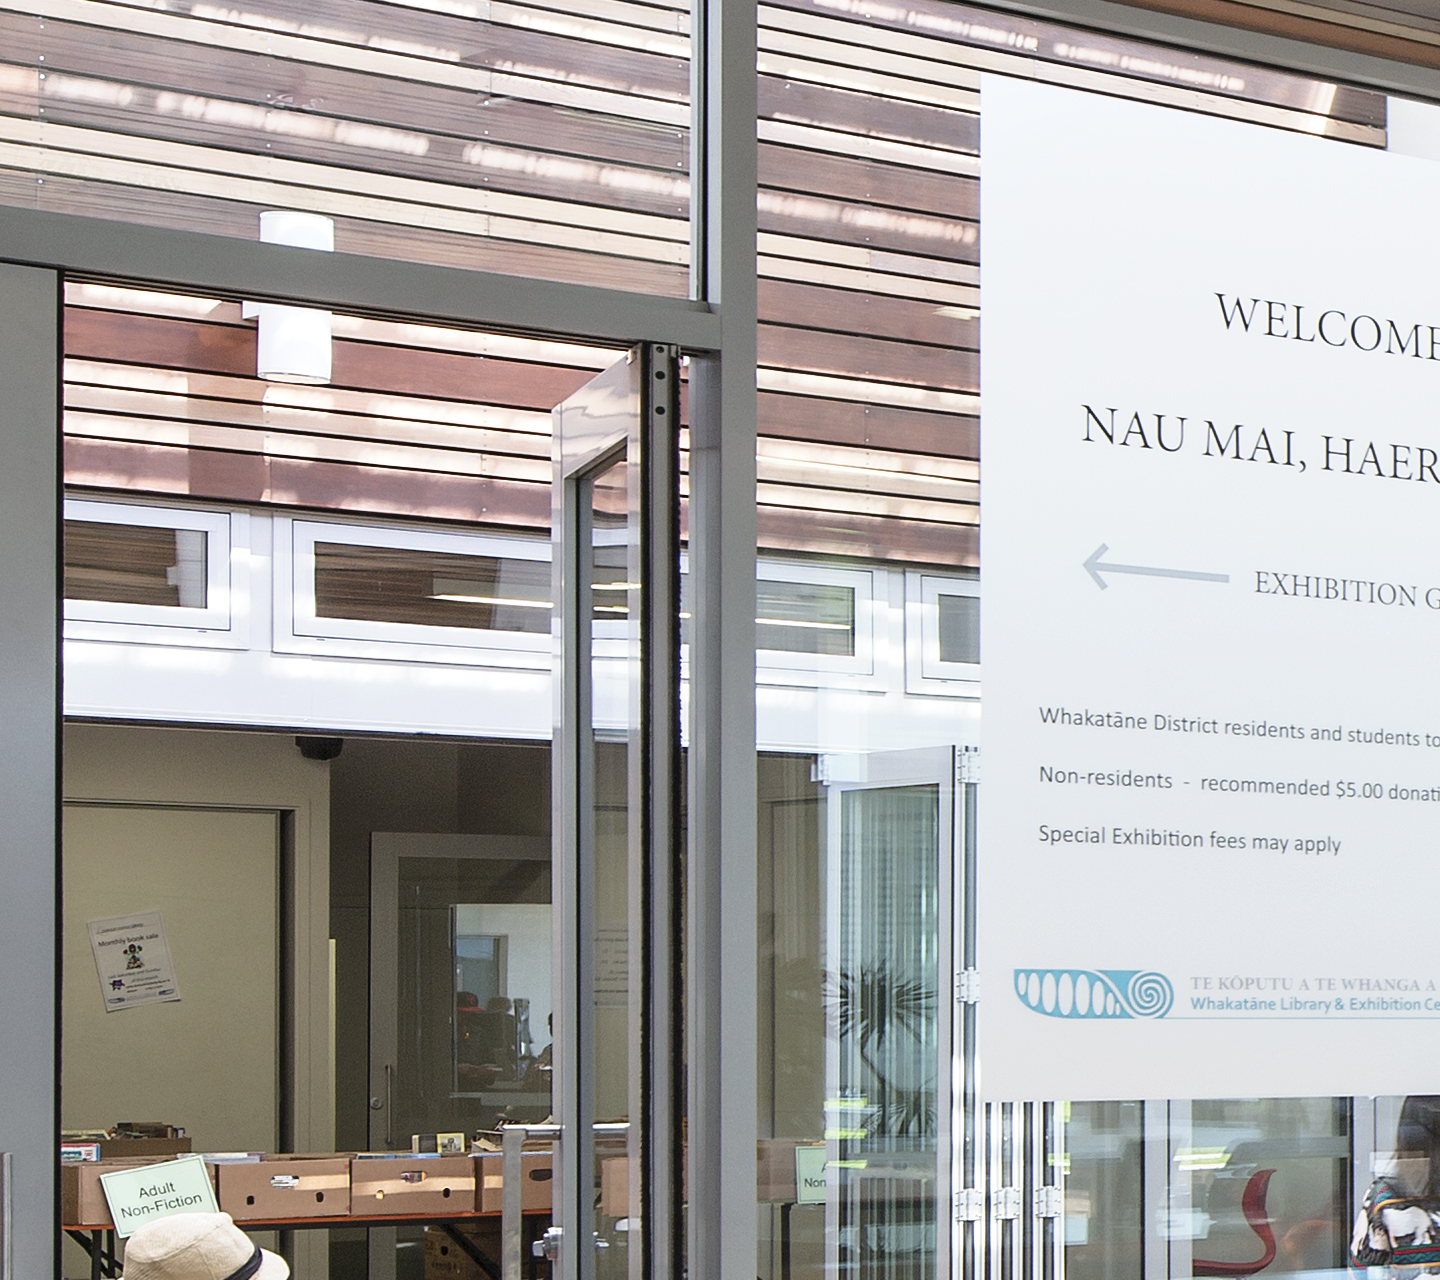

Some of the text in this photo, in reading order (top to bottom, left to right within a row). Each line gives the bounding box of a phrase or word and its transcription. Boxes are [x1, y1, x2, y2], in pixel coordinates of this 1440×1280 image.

[1081, 404, 1188, 452] NAU
[1202, 420, 1307, 473] MAI,
[1255, 570, 1417, 607] EXHIBITION
[1038, 706, 1148, 730] Whakatāne
[1153, 713, 1219, 735] District
[1224, 719, 1305, 740] residents
[1310, 725, 1342, 742] and
[1347, 727, 1421, 747] students
[1039, 765, 1173, 790] Non-residents
[1201, 777, 1331, 797] recommended
[1335, 779, 1384, 800] $5.00
[1038, 824, 1342, 857] Special Exhibition fees may apply
[1190, 977, 1214, 990] TE
[1298, 978, 1310, 991] A
[1314, 978, 1337, 991] TE
[1341, 978, 1420, 992] WHANGA
[1425, 979, 1436, 992] A
[1190, 996, 1277, 1010] Whakatāne
[1281, 996, 1332, 1015] Library
[1334, 998, 1345, 1011] &
[1350, 996, 1421, 1011] Exhibition
[121, 1194, 202, 1218] Non-Fiction
[139, 1182, 176, 1199] Adult
